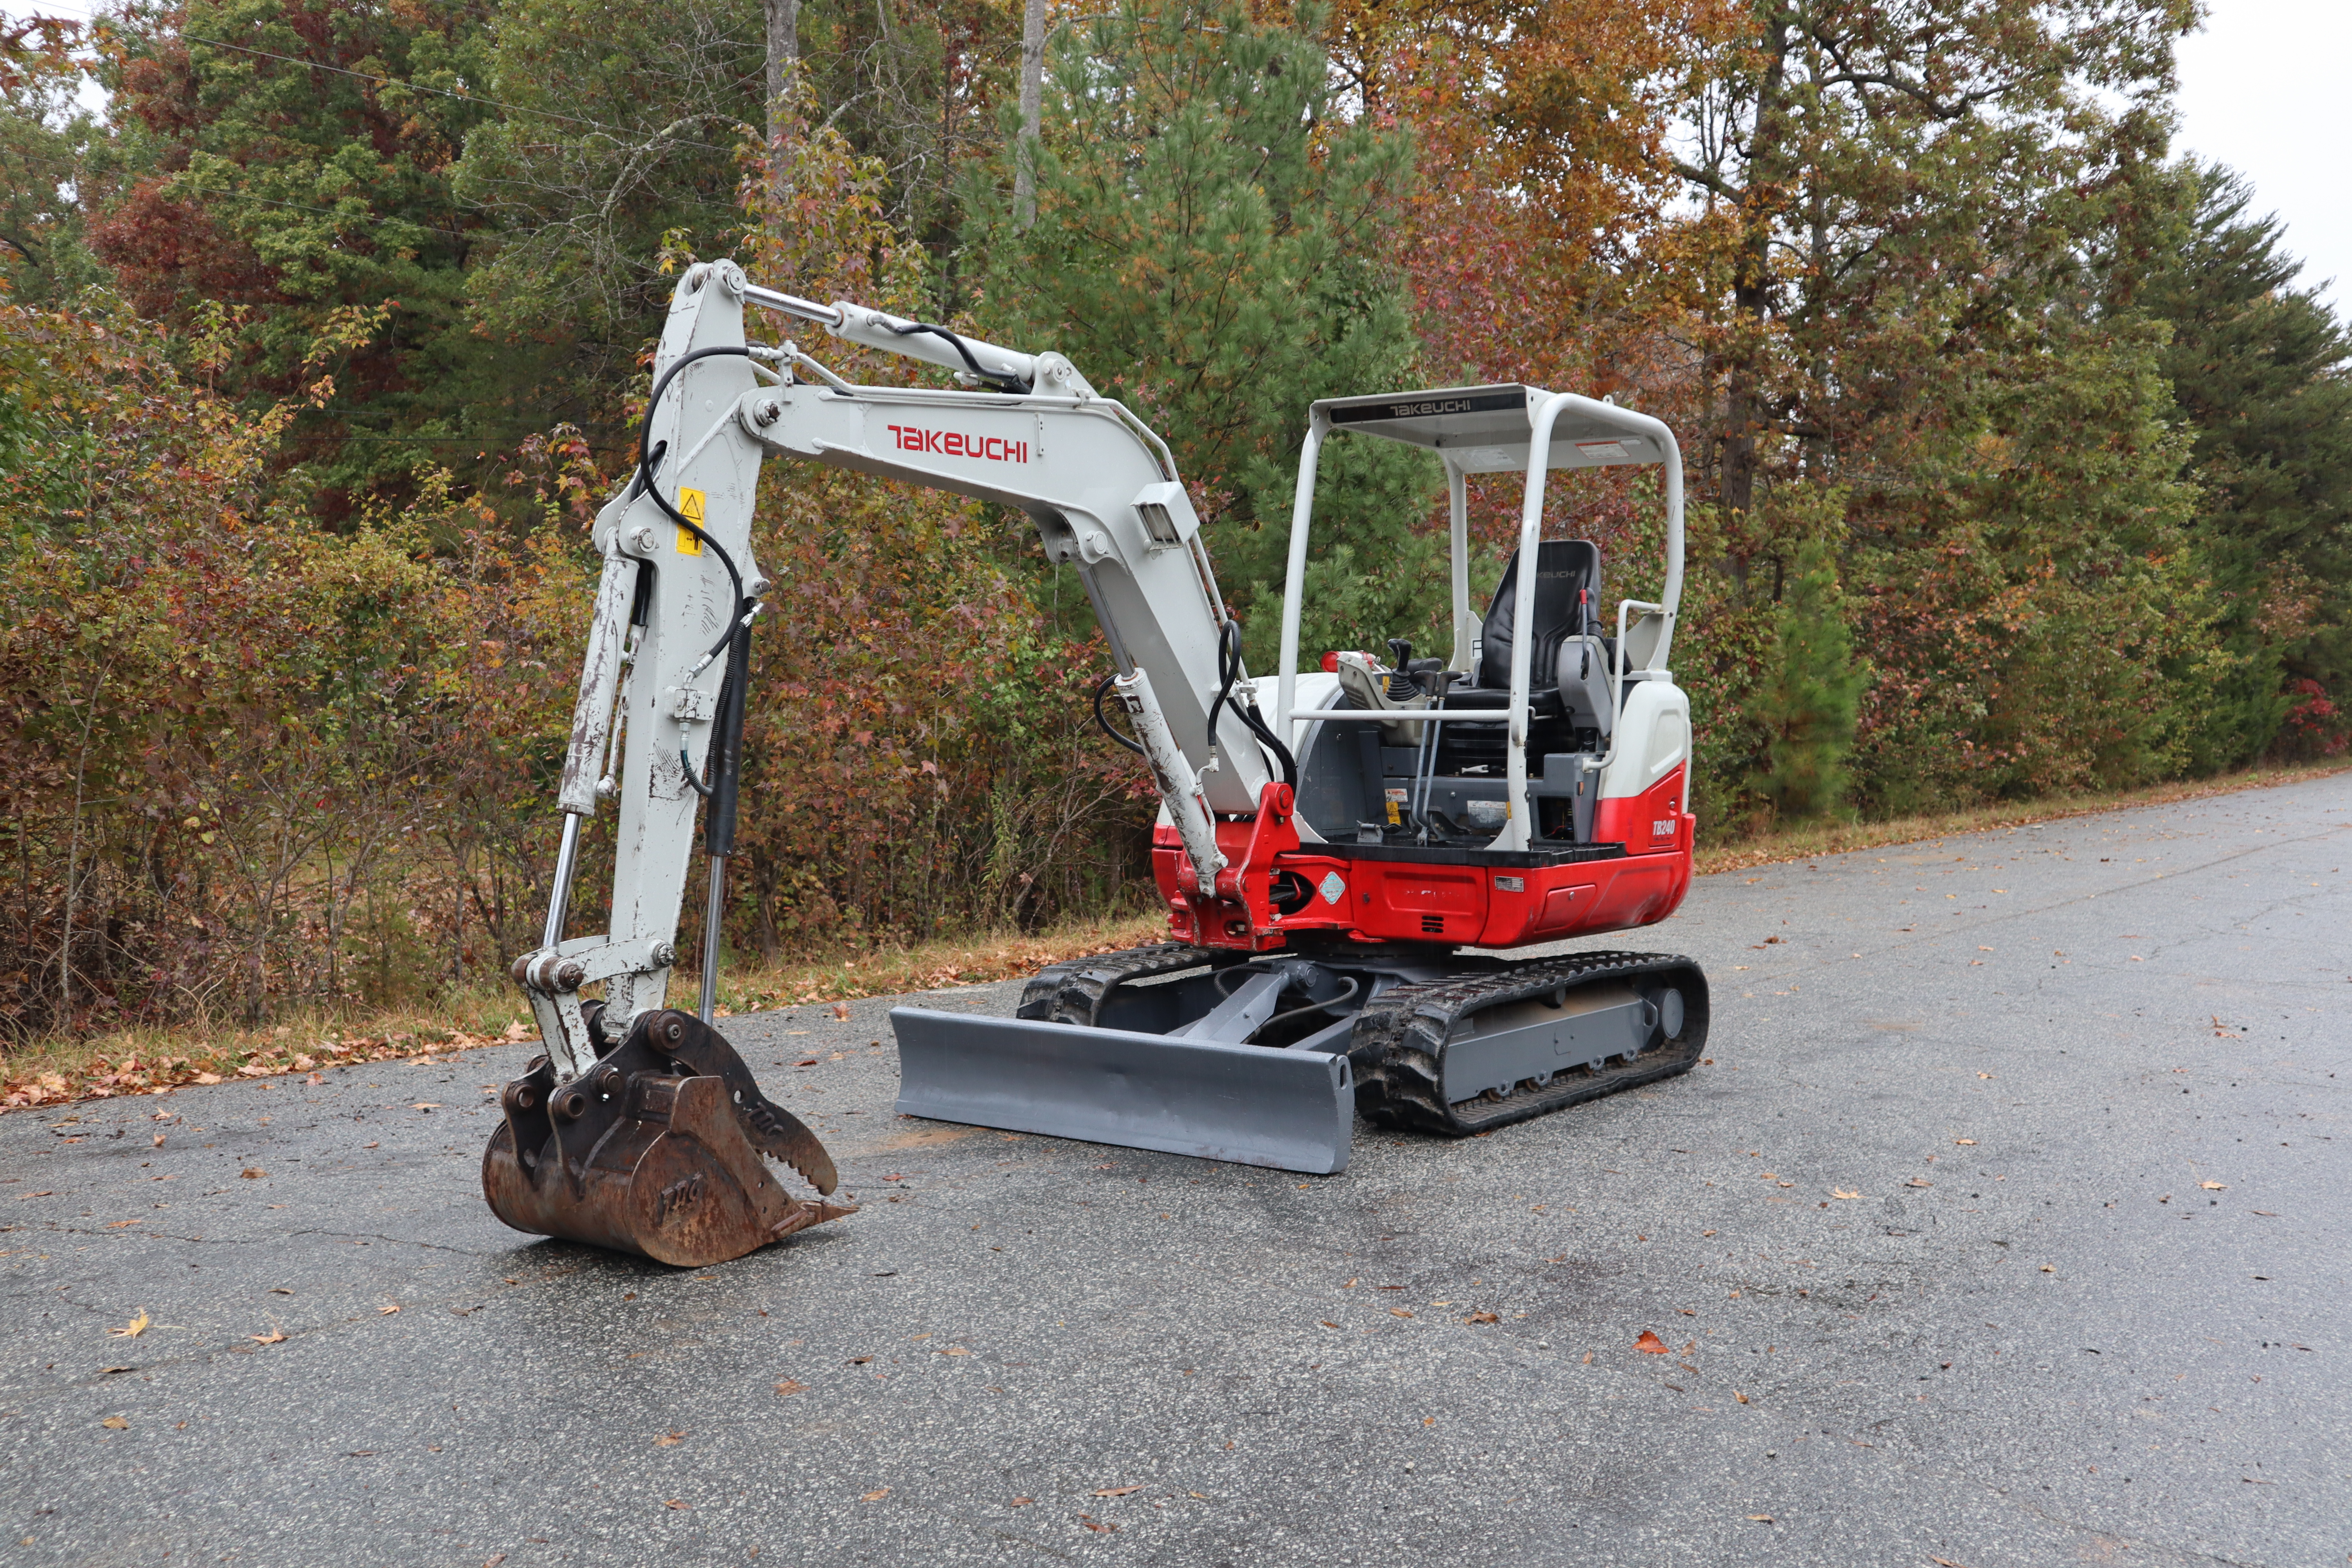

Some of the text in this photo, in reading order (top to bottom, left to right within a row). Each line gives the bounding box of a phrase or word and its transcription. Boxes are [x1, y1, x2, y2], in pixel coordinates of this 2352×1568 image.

[1390, 400, 1471, 416] TAKEUCHI
[887, 425, 1027, 463] TAKEUCHI
[1653, 819, 1675, 835] TB240
